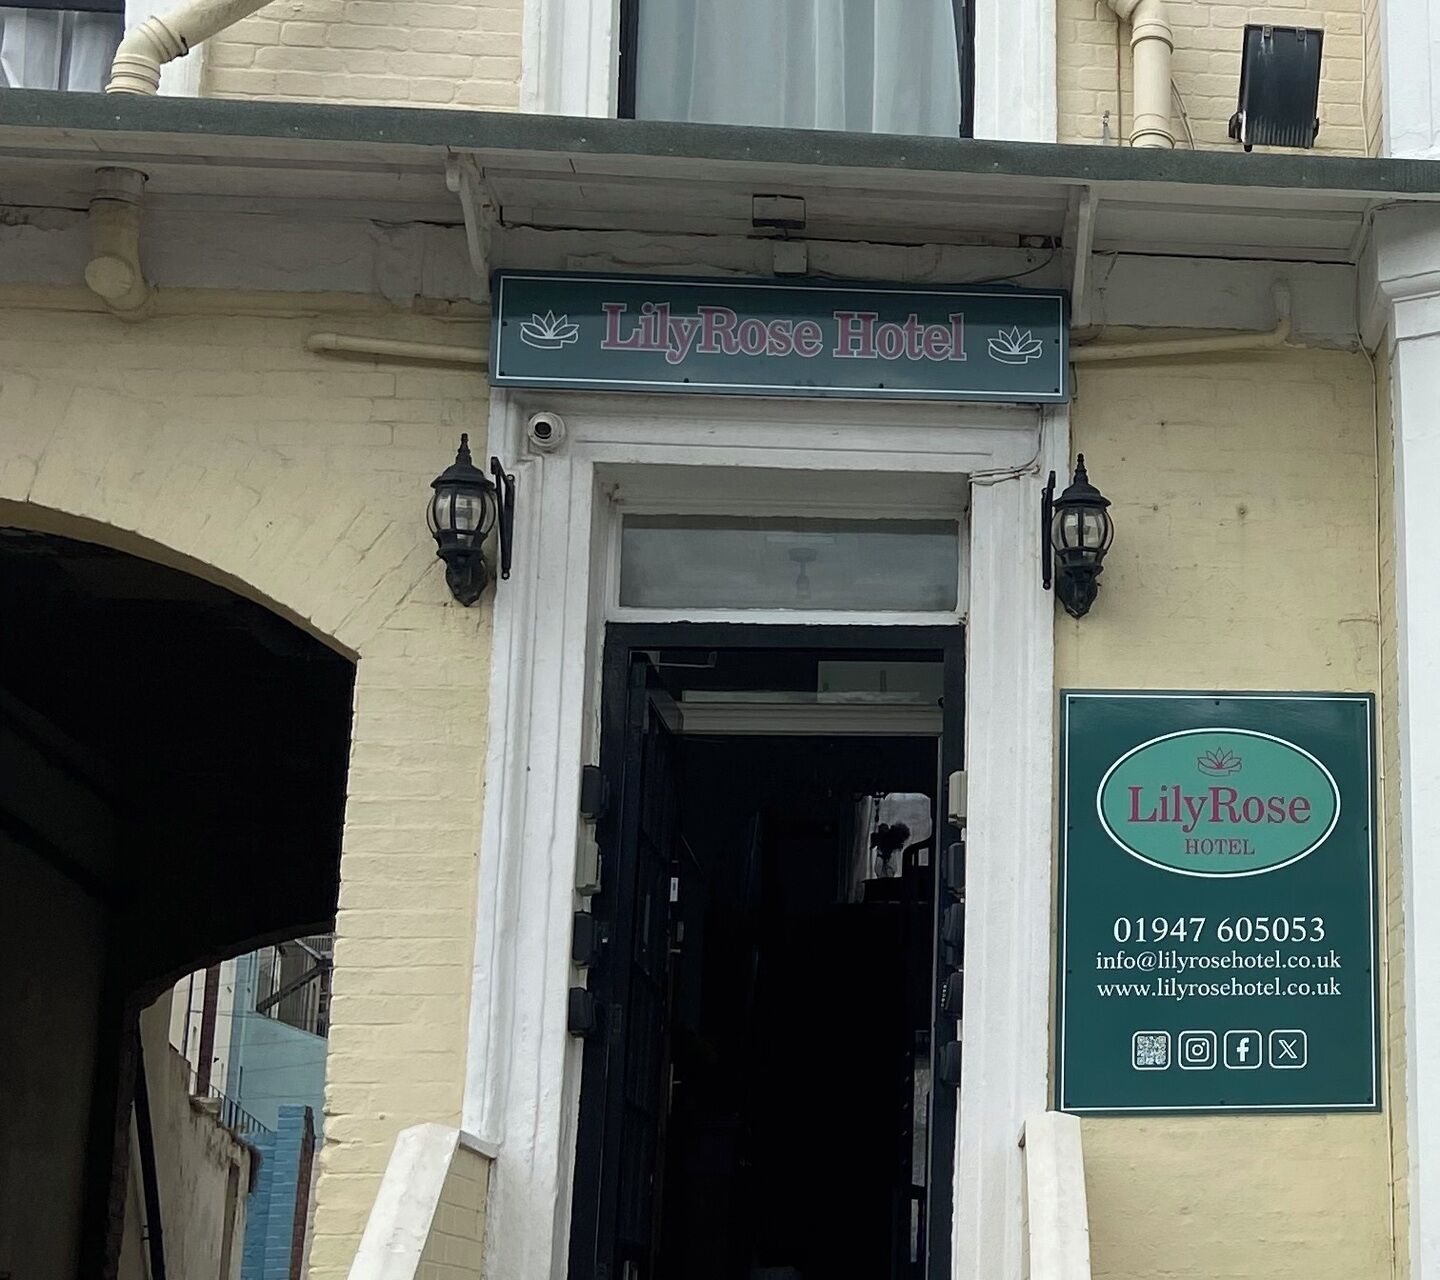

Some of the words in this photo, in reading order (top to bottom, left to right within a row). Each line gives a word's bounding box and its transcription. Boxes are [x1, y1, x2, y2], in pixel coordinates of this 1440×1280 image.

[600, 301, 824, 365] LilyRose
[832, 311, 967, 363] Hotel
[1127, 784, 1311, 833] LilyRose
[1184, 838, 1255, 856] HOTEL
[1113, 917, 1206, 943] 01947
[1217, 917, 1326, 943] 605053
[1096, 950, 1341, 974] info@lilyrosehotel.co.uk
[1097, 977, 1341, 1001] www.lilyrosehotel.co.uk
